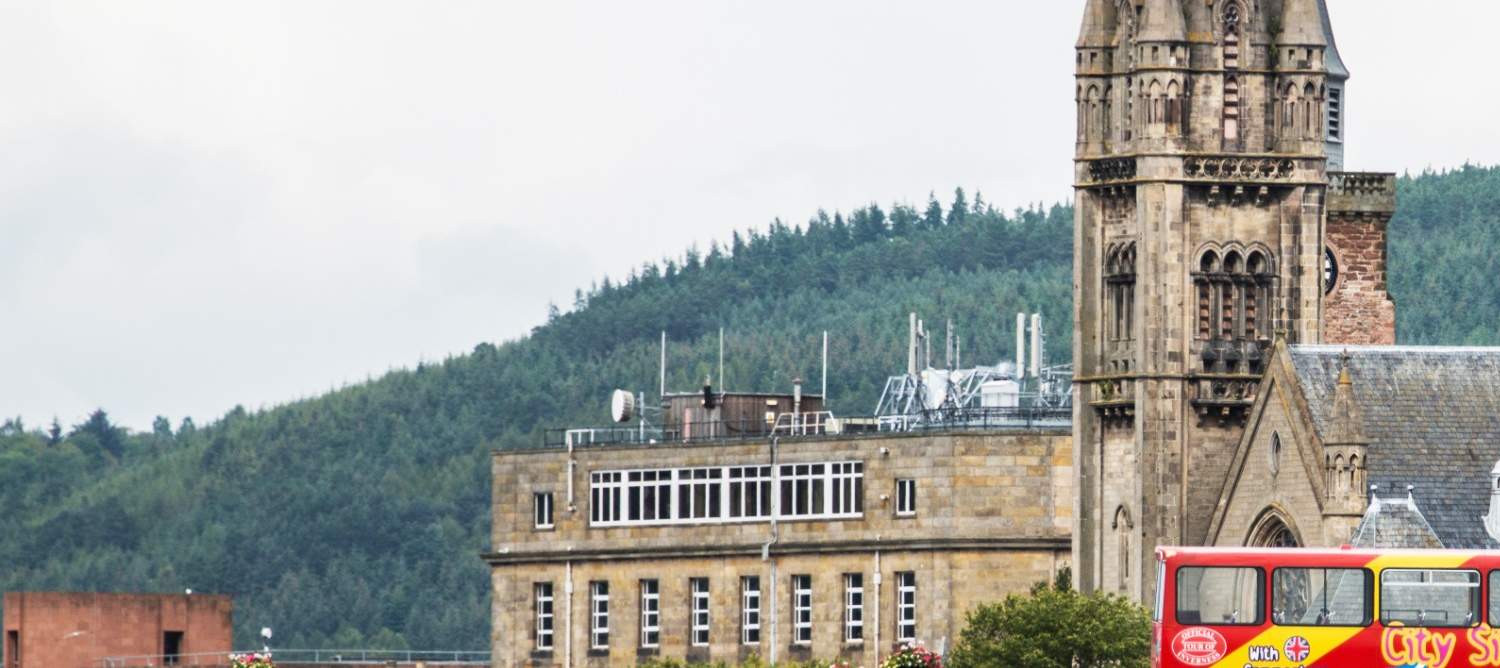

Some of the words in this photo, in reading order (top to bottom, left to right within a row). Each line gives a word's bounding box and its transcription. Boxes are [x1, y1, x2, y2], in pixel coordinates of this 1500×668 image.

[1182, 628, 1216, 641] OFFICIAL
[1184, 642, 1205, 651] TOUR
[1382, 621, 1456, 668] City
[1178, 650, 1220, 664] INVERNESS
[1249, 645, 1279, 661] With
